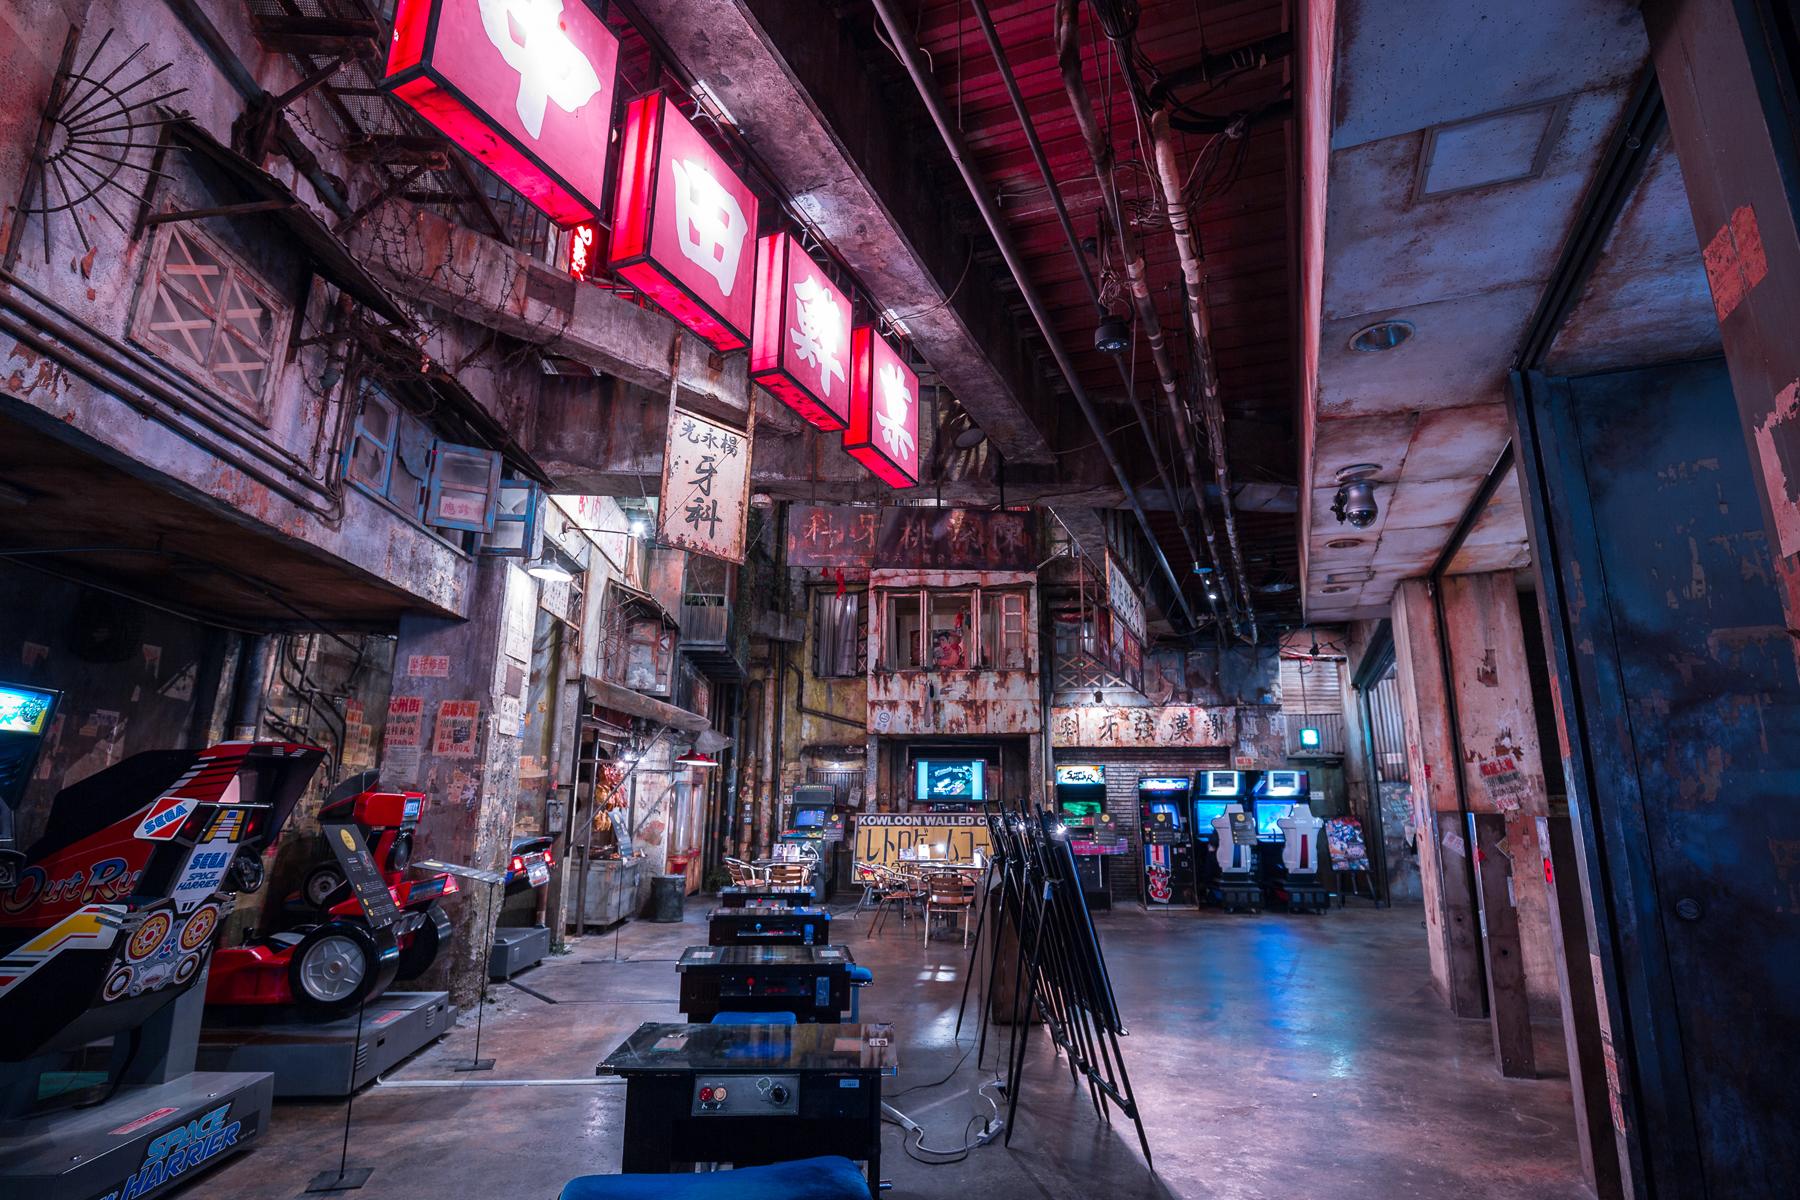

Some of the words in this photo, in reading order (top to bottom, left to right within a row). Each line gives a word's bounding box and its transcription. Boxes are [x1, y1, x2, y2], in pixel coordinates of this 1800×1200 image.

[685, 455, 723, 540] 牙科
[143, 804, 188, 835] SEGA
[859, 815, 921, 827] KOWLOON
[923, 815, 975, 827] WALLED
[188, 852, 228, 870] SEGA
[176, 880, 219, 891] HARRIER
[187, 871, 219, 881] SPACE
[147, 1102, 232, 1162] SPACE
[120, 1120, 241, 1200] HARRIER
